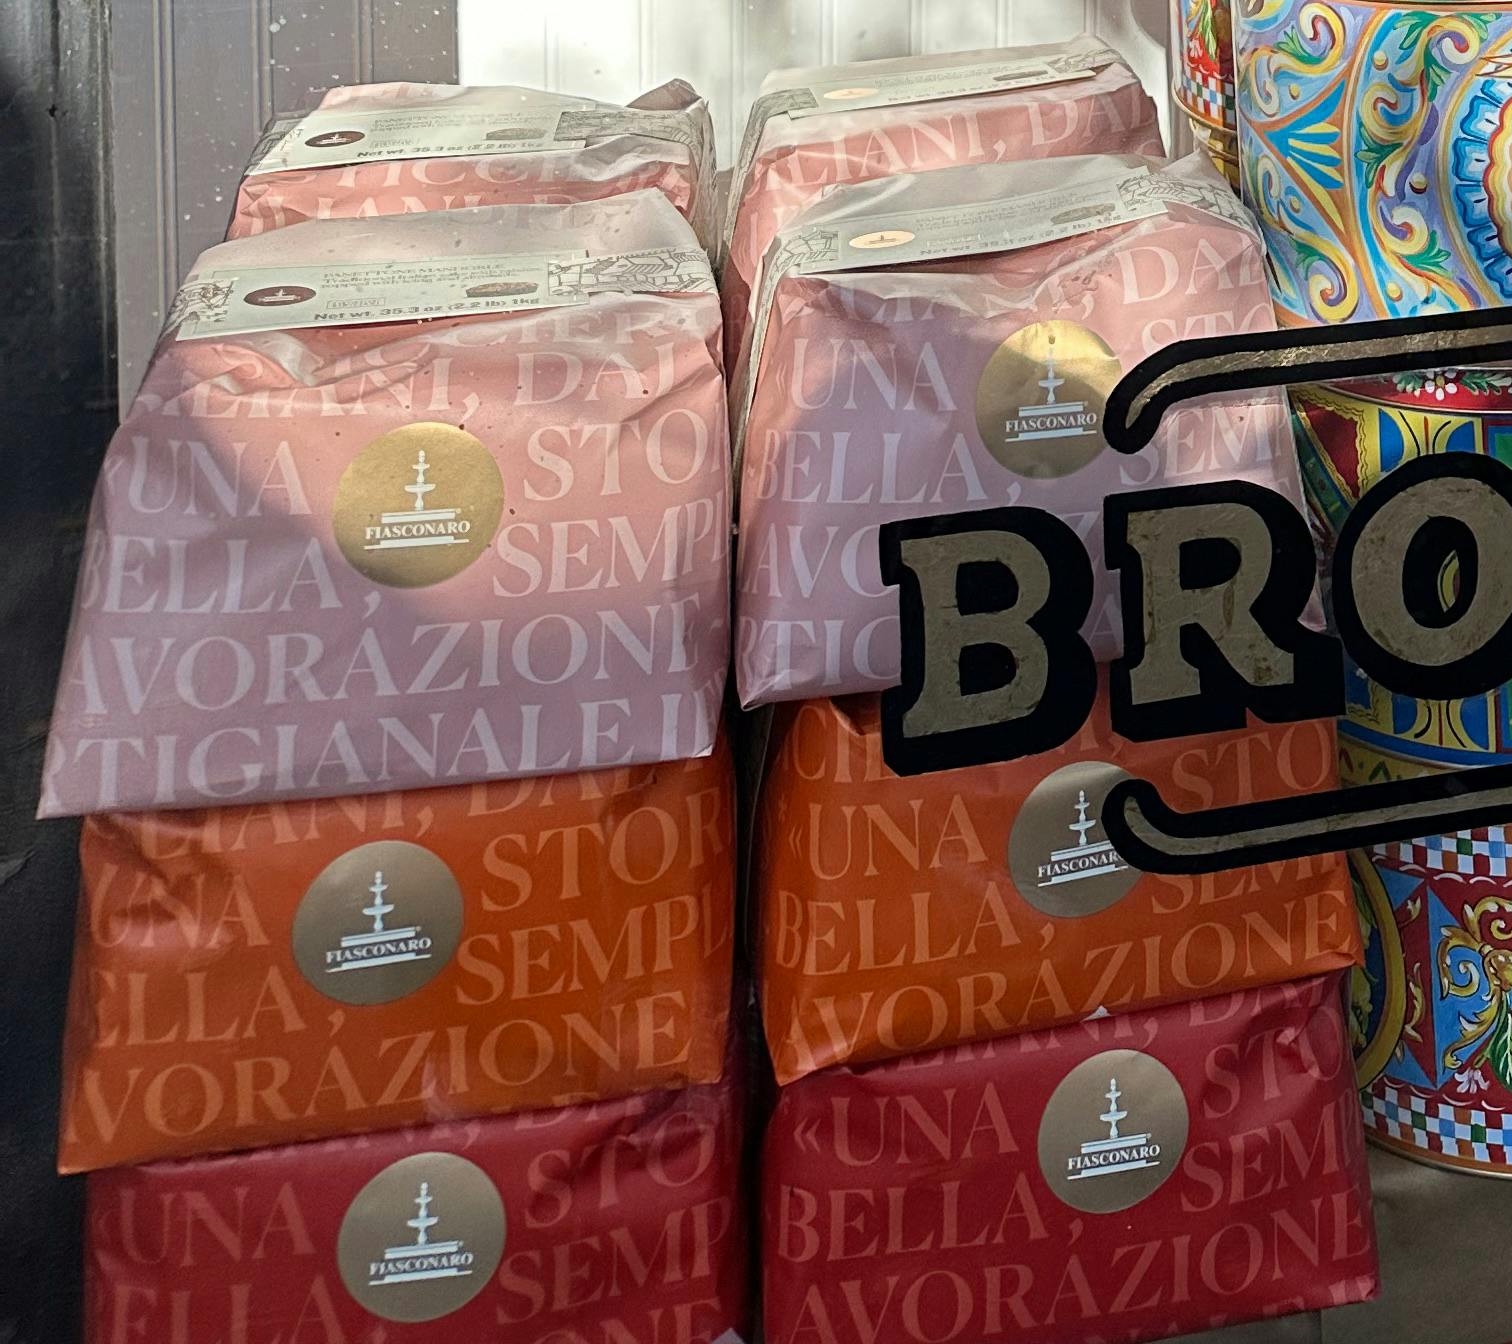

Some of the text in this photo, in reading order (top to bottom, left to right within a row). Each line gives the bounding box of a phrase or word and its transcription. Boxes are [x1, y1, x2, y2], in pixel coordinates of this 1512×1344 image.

[789, 336, 958, 414] UNA
[127, 407, 731, 516] UNA STO
[1004, 411, 1098, 434] FIASCONARO
[365, 518, 471, 542] FIASCONARO
[481, 786, 726, 913] STOR
[325, 934, 432, 965] FIASCONARO
[773, 879, 1055, 977] BELLA,
[1067, 1143, 1161, 1172] FIASCONARO
[114, 1180, 317, 1269] UNA
[775, 1171, 1083, 1265] BELLA,
[368, 1250, 474, 1278] FIASCONARO
